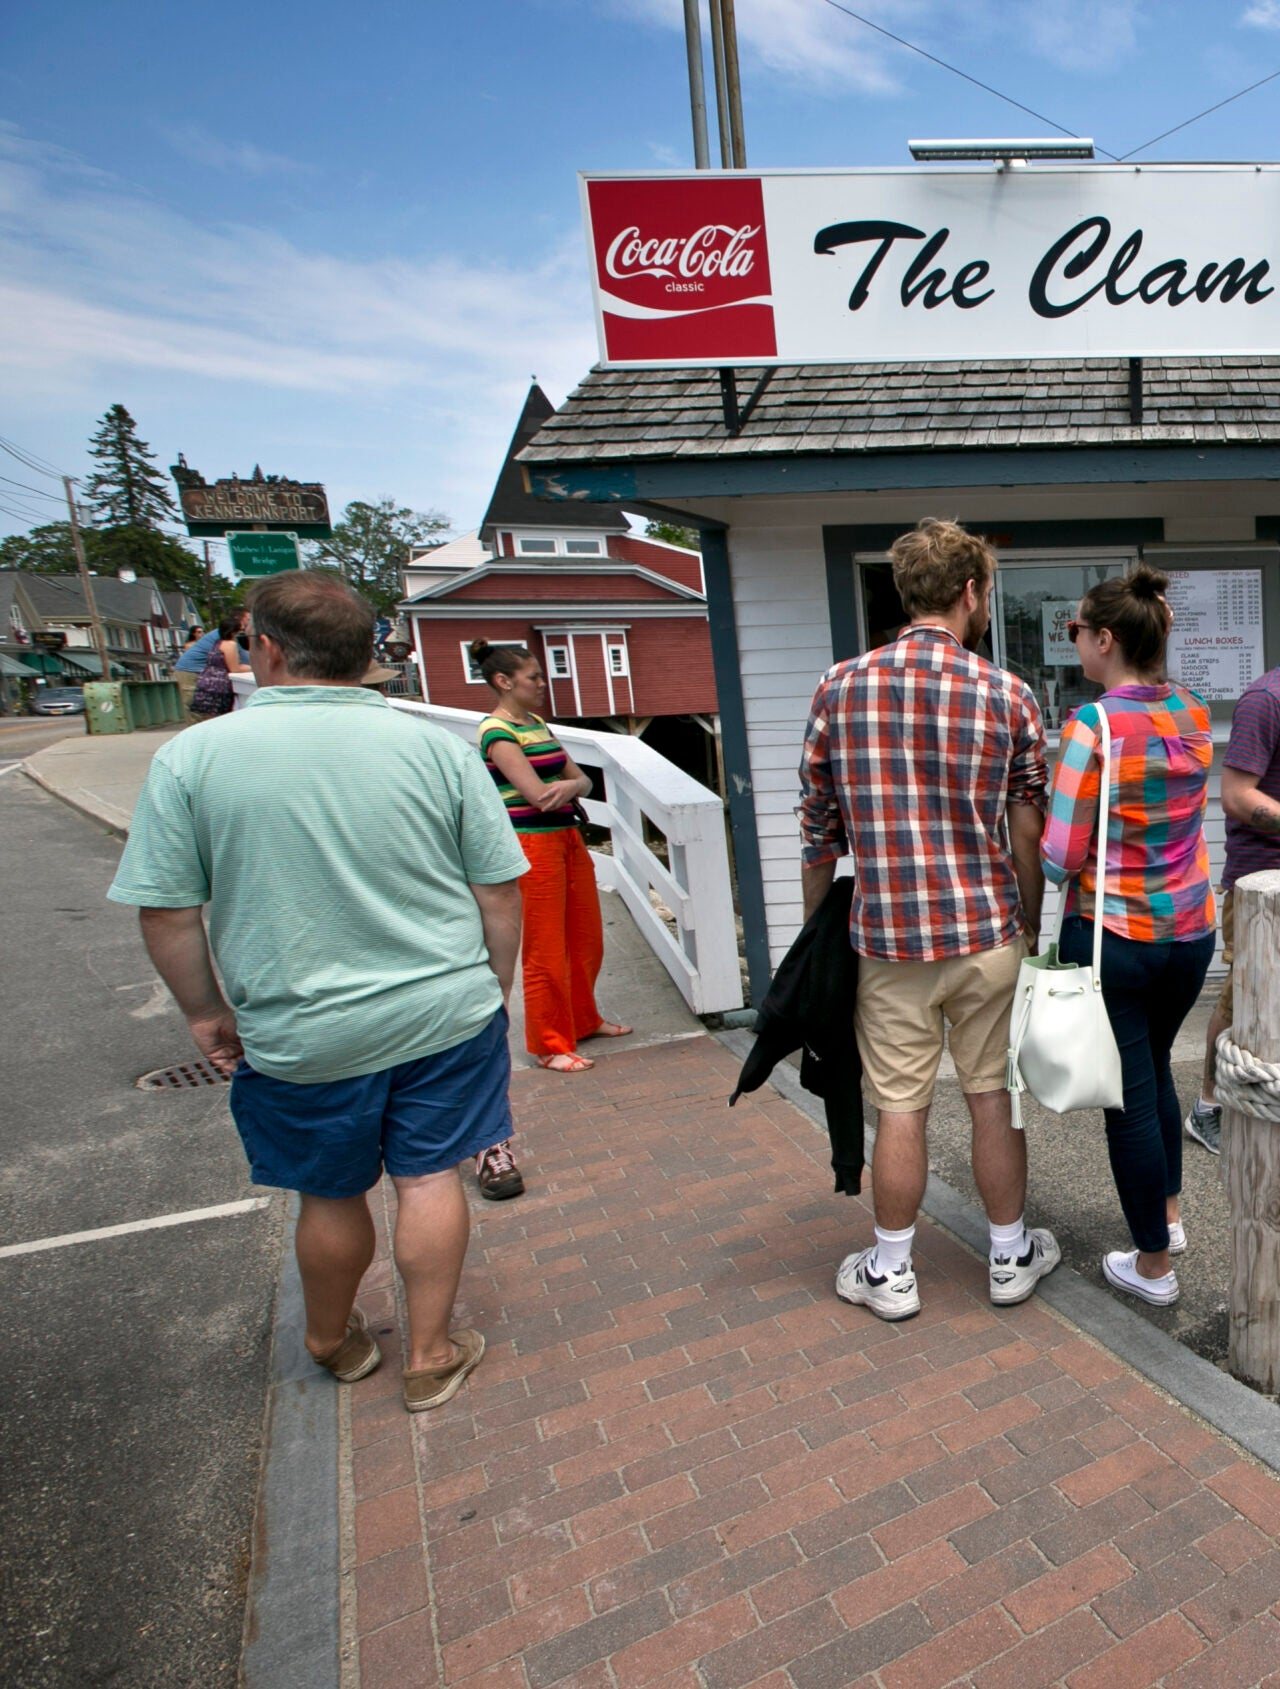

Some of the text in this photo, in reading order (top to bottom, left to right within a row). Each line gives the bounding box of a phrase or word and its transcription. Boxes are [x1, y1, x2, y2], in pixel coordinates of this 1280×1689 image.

[605, 224, 761, 279] Coca-Cola
[814, 220, 995, 312] The
[1028, 216, 1274, 319] Clam
[665, 280, 704, 293] classic
[203, 491, 302, 507] WELCOME TO
[194, 504, 317, 521] KENNEBUNKPORT
[1055, 609, 1071, 620] OH
[1052, 620, 1068, 631] YE
[1048, 632, 1065, 643] WE
[1184, 637, 1244, 646] LUNCH BOXES
